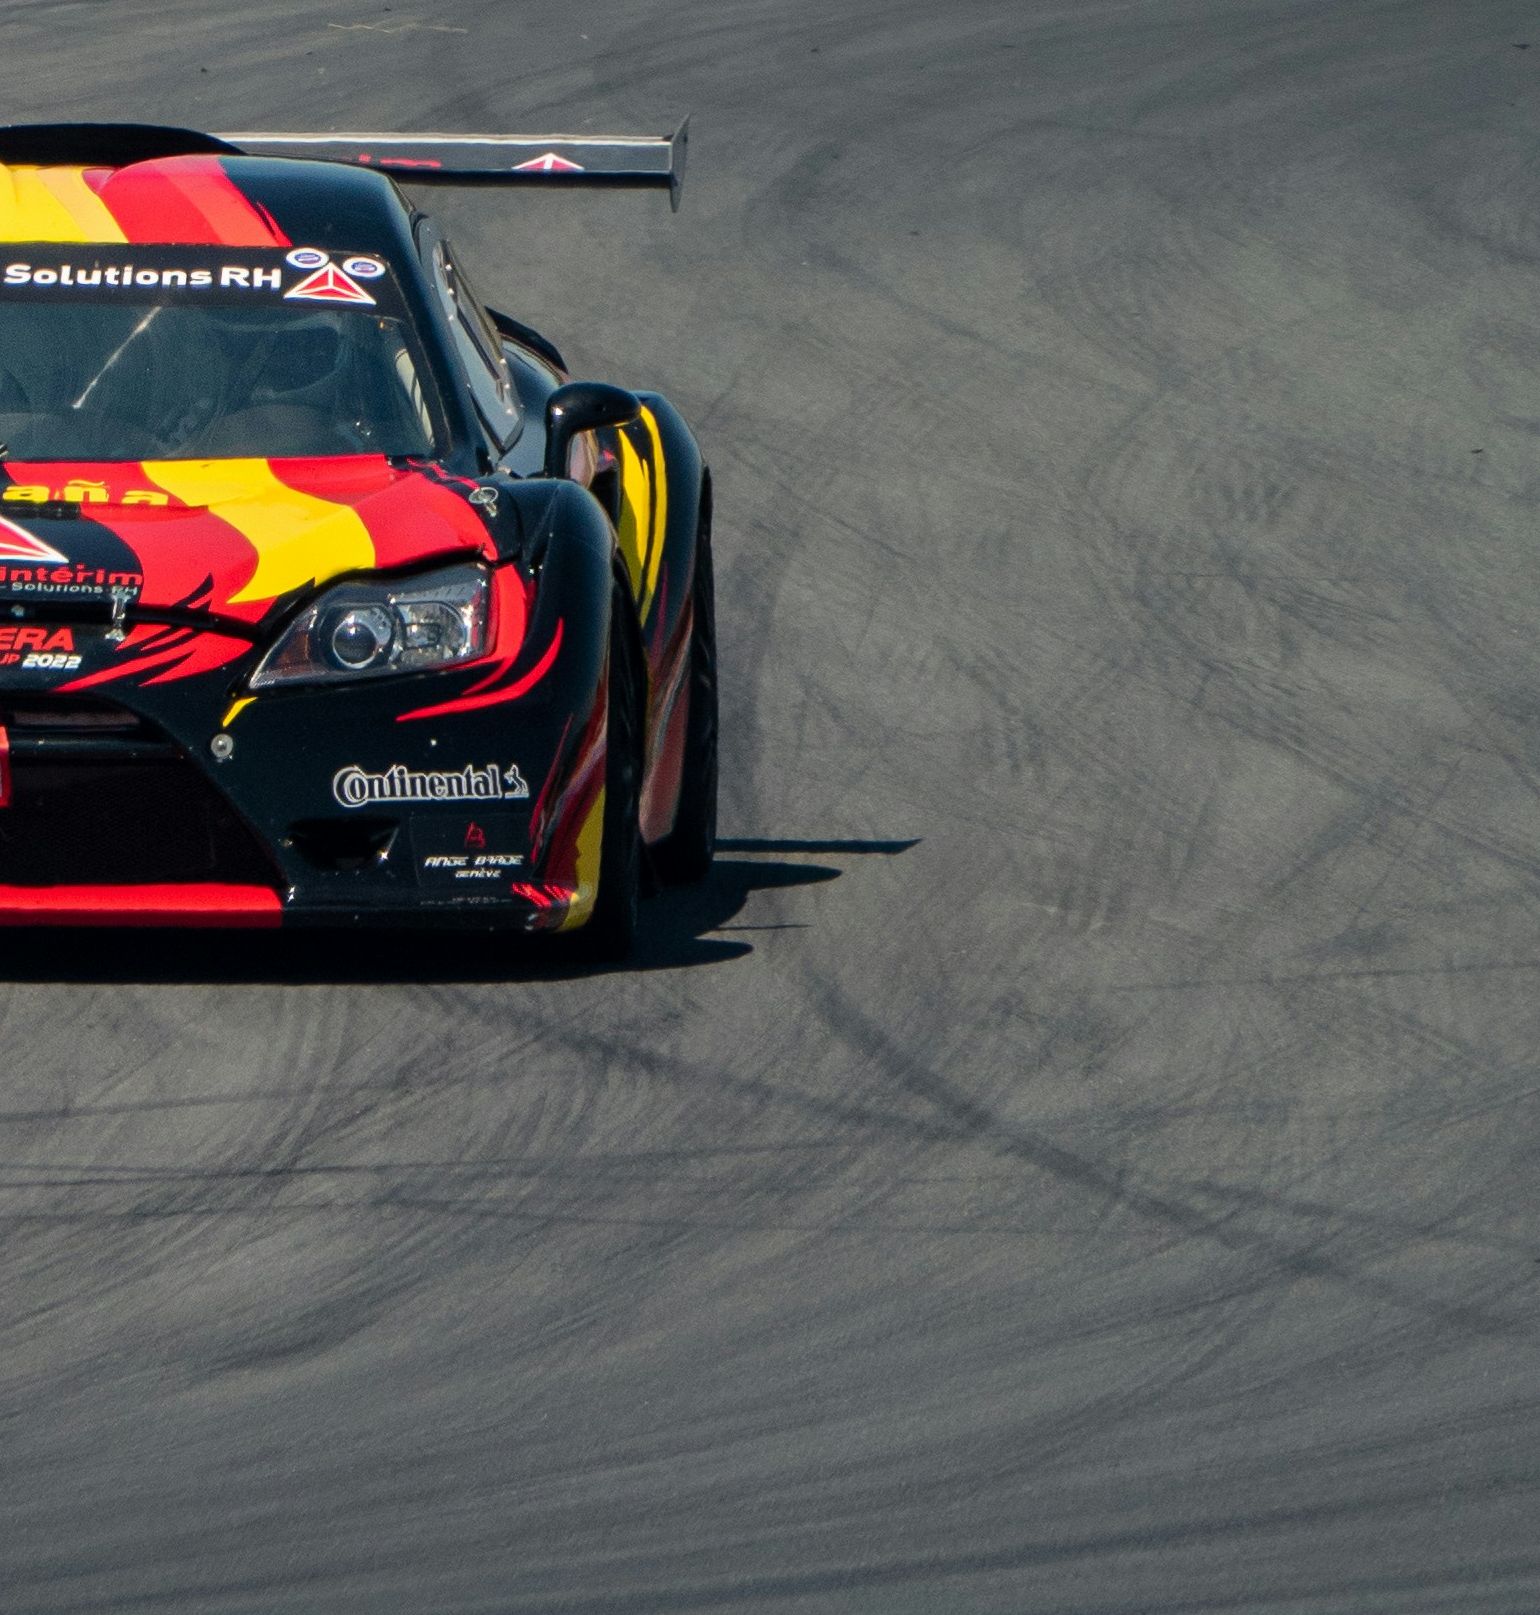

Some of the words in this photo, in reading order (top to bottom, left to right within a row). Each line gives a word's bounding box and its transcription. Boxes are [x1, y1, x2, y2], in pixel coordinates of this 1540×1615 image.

[3, 263, 213, 286] Solutions
[220, 266, 282, 289] RH
[11, 581, 103, 594] Solutions
[22, 652, 83, 670] 2022
[333, 764, 503, 807] Continental
